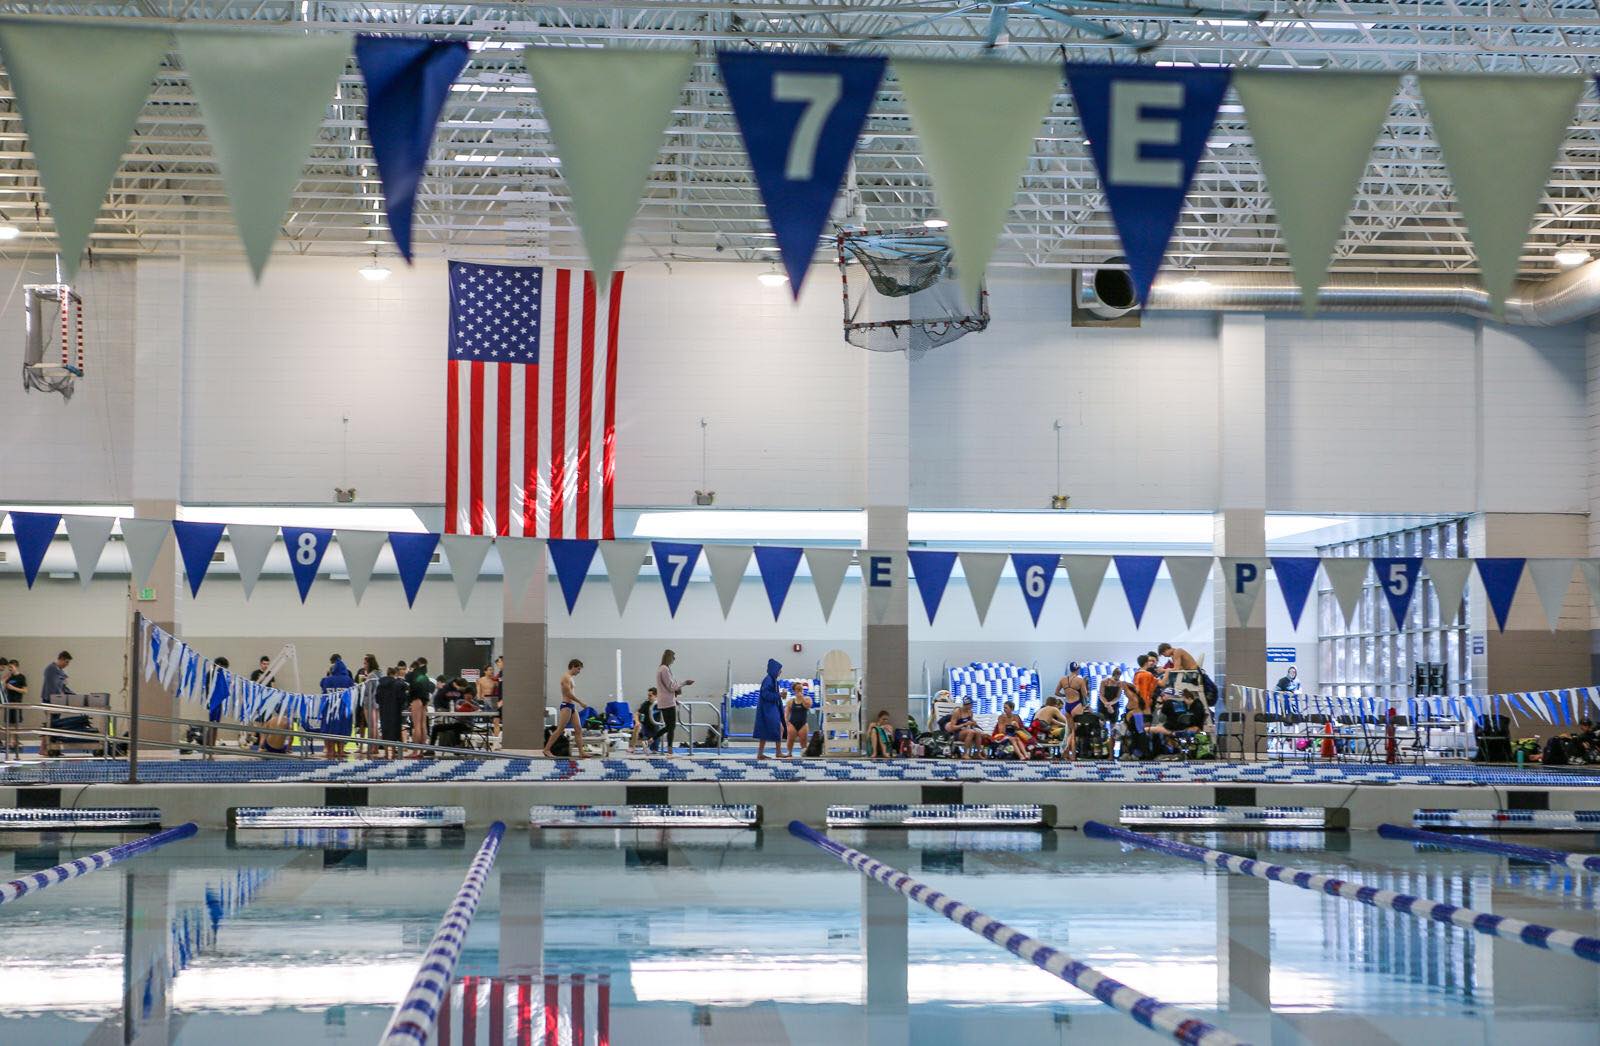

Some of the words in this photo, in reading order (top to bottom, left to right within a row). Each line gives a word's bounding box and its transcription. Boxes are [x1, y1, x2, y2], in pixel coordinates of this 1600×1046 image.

[773, 74, 842, 181] 7
[1107, 82, 1185, 186] E
[296, 532, 317, 565] 8
[668, 555, 689, 587] 7
[869, 556, 893, 588] E
[1025, 565, 1045, 598] 6
[1235, 562, 1258, 594] P
[1389, 564, 1408, 596] 5
